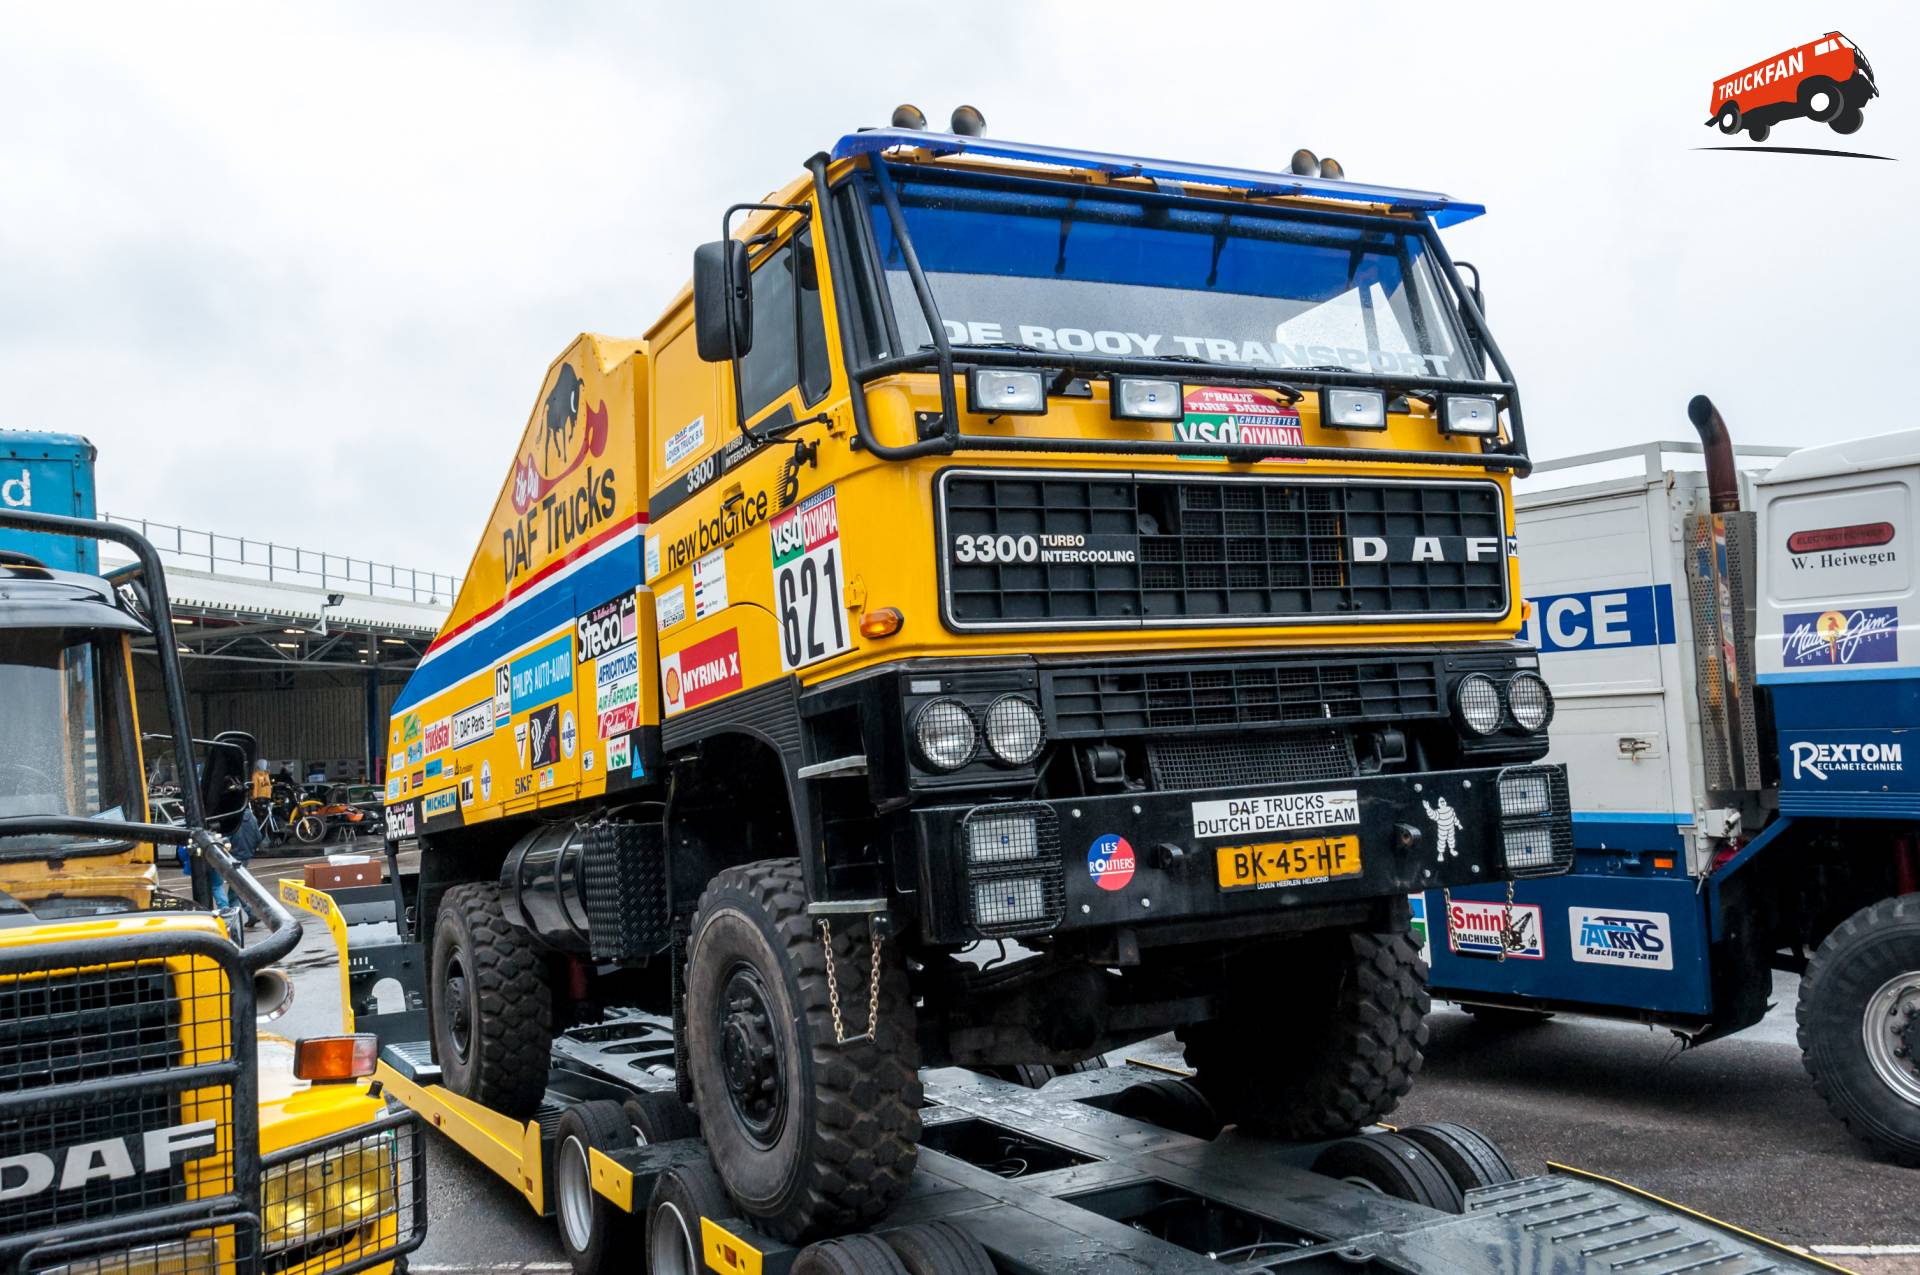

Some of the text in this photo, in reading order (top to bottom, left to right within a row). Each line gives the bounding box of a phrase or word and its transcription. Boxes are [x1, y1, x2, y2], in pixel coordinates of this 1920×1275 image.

[929, 320, 1450, 377] DE ROOY TRANSPORT
[1188, 402, 1280, 414] PARIS DAKAR
[1215, 392, 1254, 403] RALLYE
[1239, 415, 1297, 426] CHAUSSETTES
[726, 435, 743, 454] TURBO
[1240, 427, 1302, 446] OLYMPIA
[687, 457, 714, 493] 3300
[802, 486, 834, 511] CHAUSSETTES
[503, 466, 616, 584] DAF Trucks
[668, 530, 697, 571] new
[699, 490, 768, 554] balance
[772, 506, 803, 557] vsd
[803, 500, 839, 547] OLYMPIA
[955, 534, 1085, 563] 3300 TURBO
[1041, 550, 1135, 563] INTERCOOLING
[1791, 551, 1896, 570] W. Heiwegen
[780, 548, 844, 667] 621
[578, 614, 620, 662] Steco
[512, 651, 570, 700] PHILIPS AUTO-AUDIO
[598, 651, 637, 684] AFRICATOURS
[682, 652, 740, 694] MYRINA X
[612, 683, 638, 705] AFRIQUE
[460, 715, 485, 739] DAF Parts
[1789, 741, 1902, 780] REXTOM
[515, 774, 533, 795] SKF
[426, 792, 456, 812] MICHELIN
[1229, 794, 1324, 817] DAF TRUCKS
[1198, 807, 1356, 835] DUTCH DEALERTEAM
[1101, 842, 1118, 854] LES
[1089, 858, 1135, 872] ROUTIERS
[1234, 843, 1347, 879] BK-45-HF
[1257, 882, 1276, 890] LOVEN
[1276, 879, 1301, 888] HEERLEN
[1586, 948, 1659, 961] Racing Team
[0, 1119, 217, 1200] DAF
